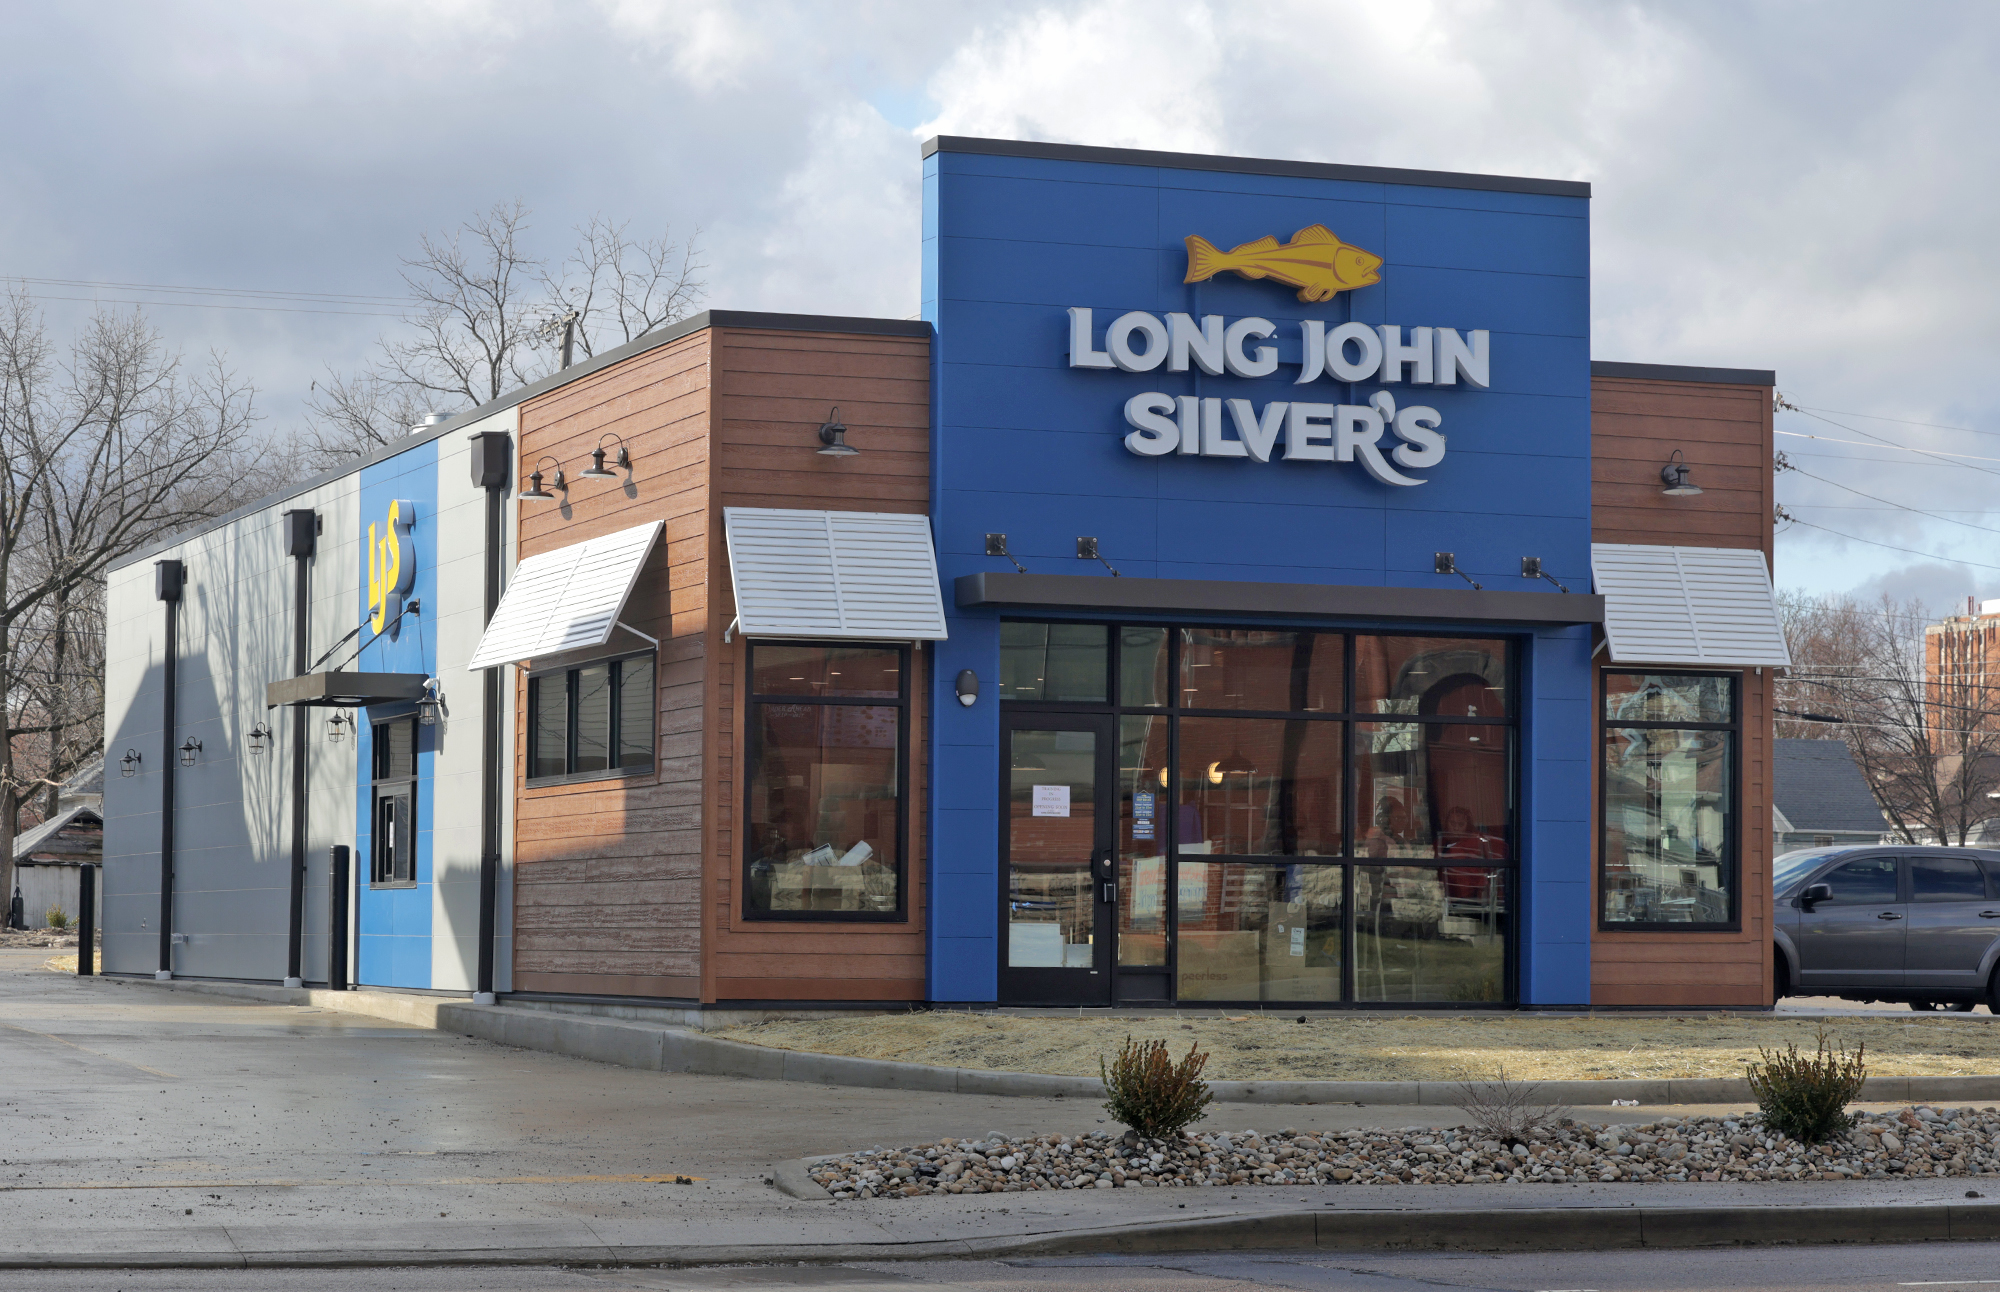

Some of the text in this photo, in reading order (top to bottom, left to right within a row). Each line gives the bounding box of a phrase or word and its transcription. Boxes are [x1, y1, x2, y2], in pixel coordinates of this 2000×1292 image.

[1067, 307, 1490, 388] LONG JOHN
[1124, 390, 1446, 486] SILVER'S
[368, 499, 406, 636] LJS
[1181, 967, 1228, 986] peerless
